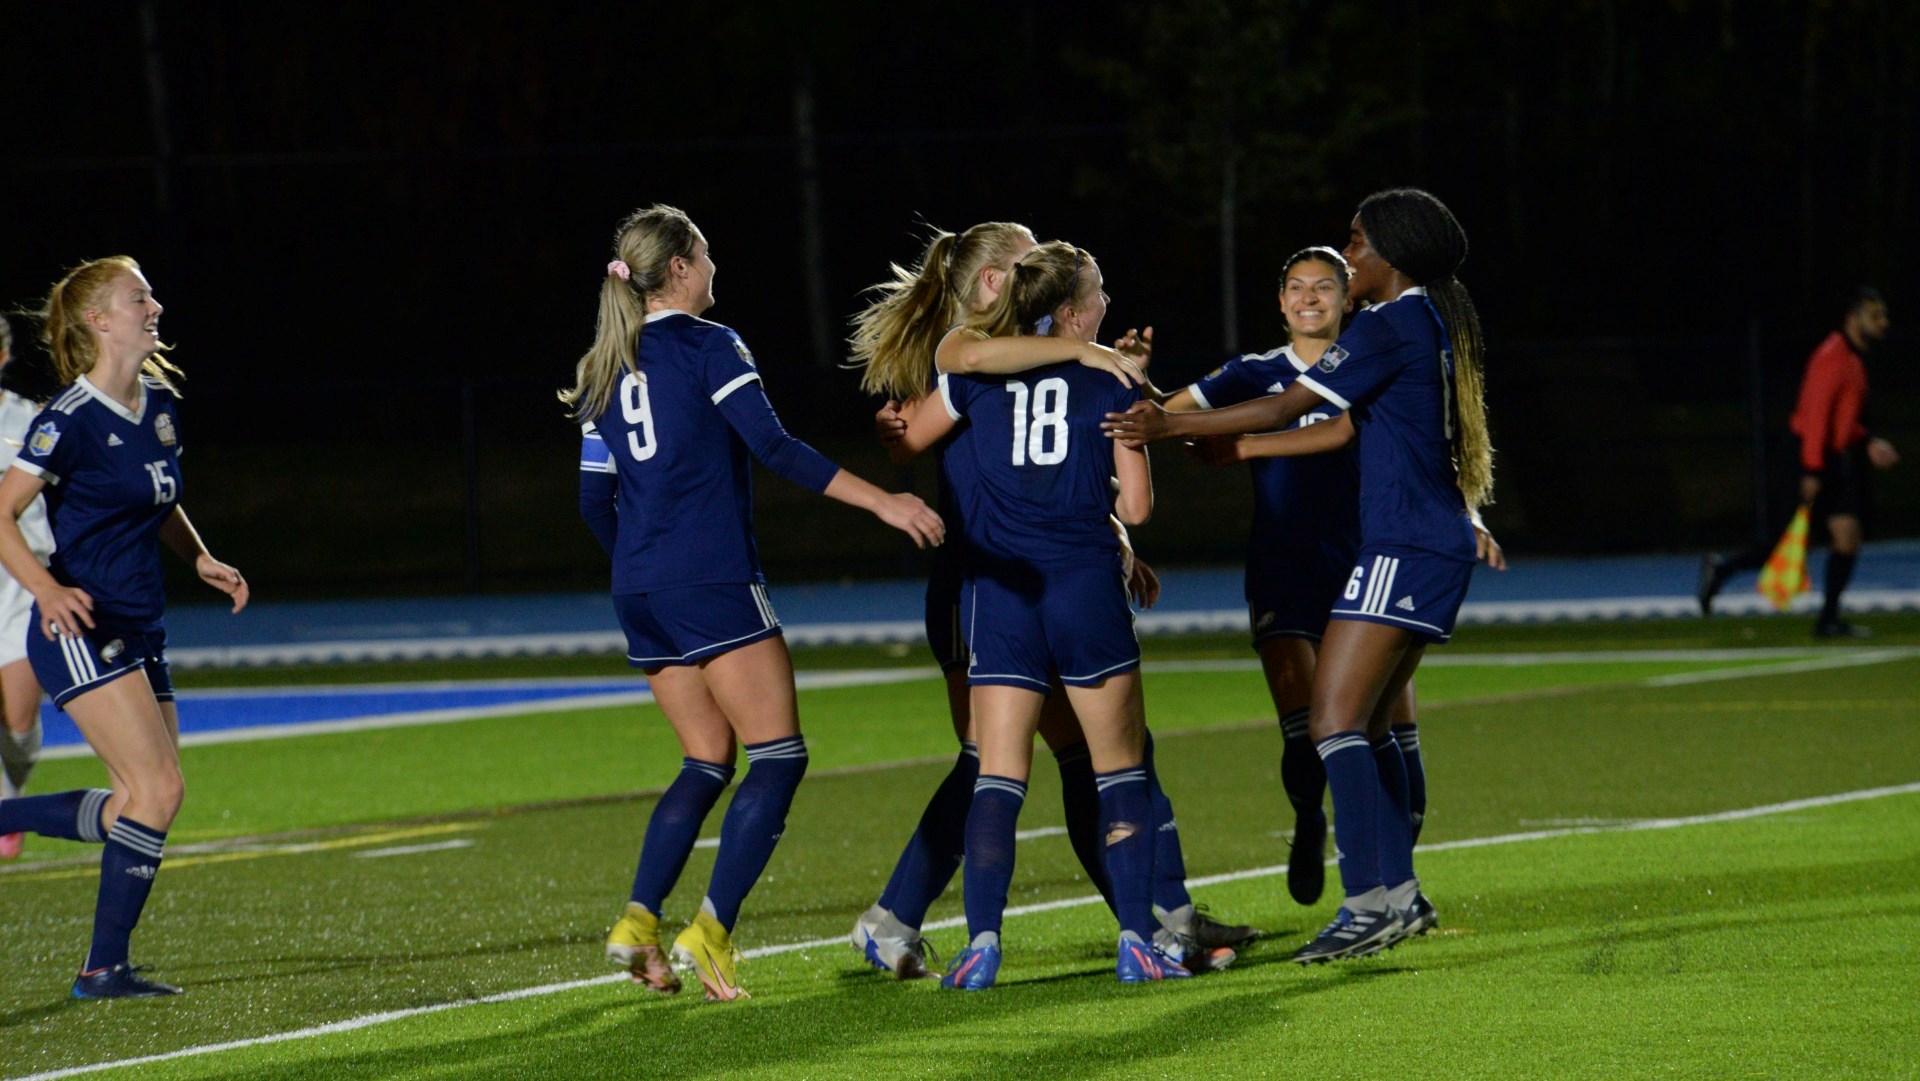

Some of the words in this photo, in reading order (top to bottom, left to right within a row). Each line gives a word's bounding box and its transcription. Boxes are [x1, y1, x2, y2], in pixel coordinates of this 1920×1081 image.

[620, 371, 657, 462] 9
[1006, 378, 1069, 466] 18
[144, 460, 176, 505] 15
[1344, 566, 1364, 601] 6
